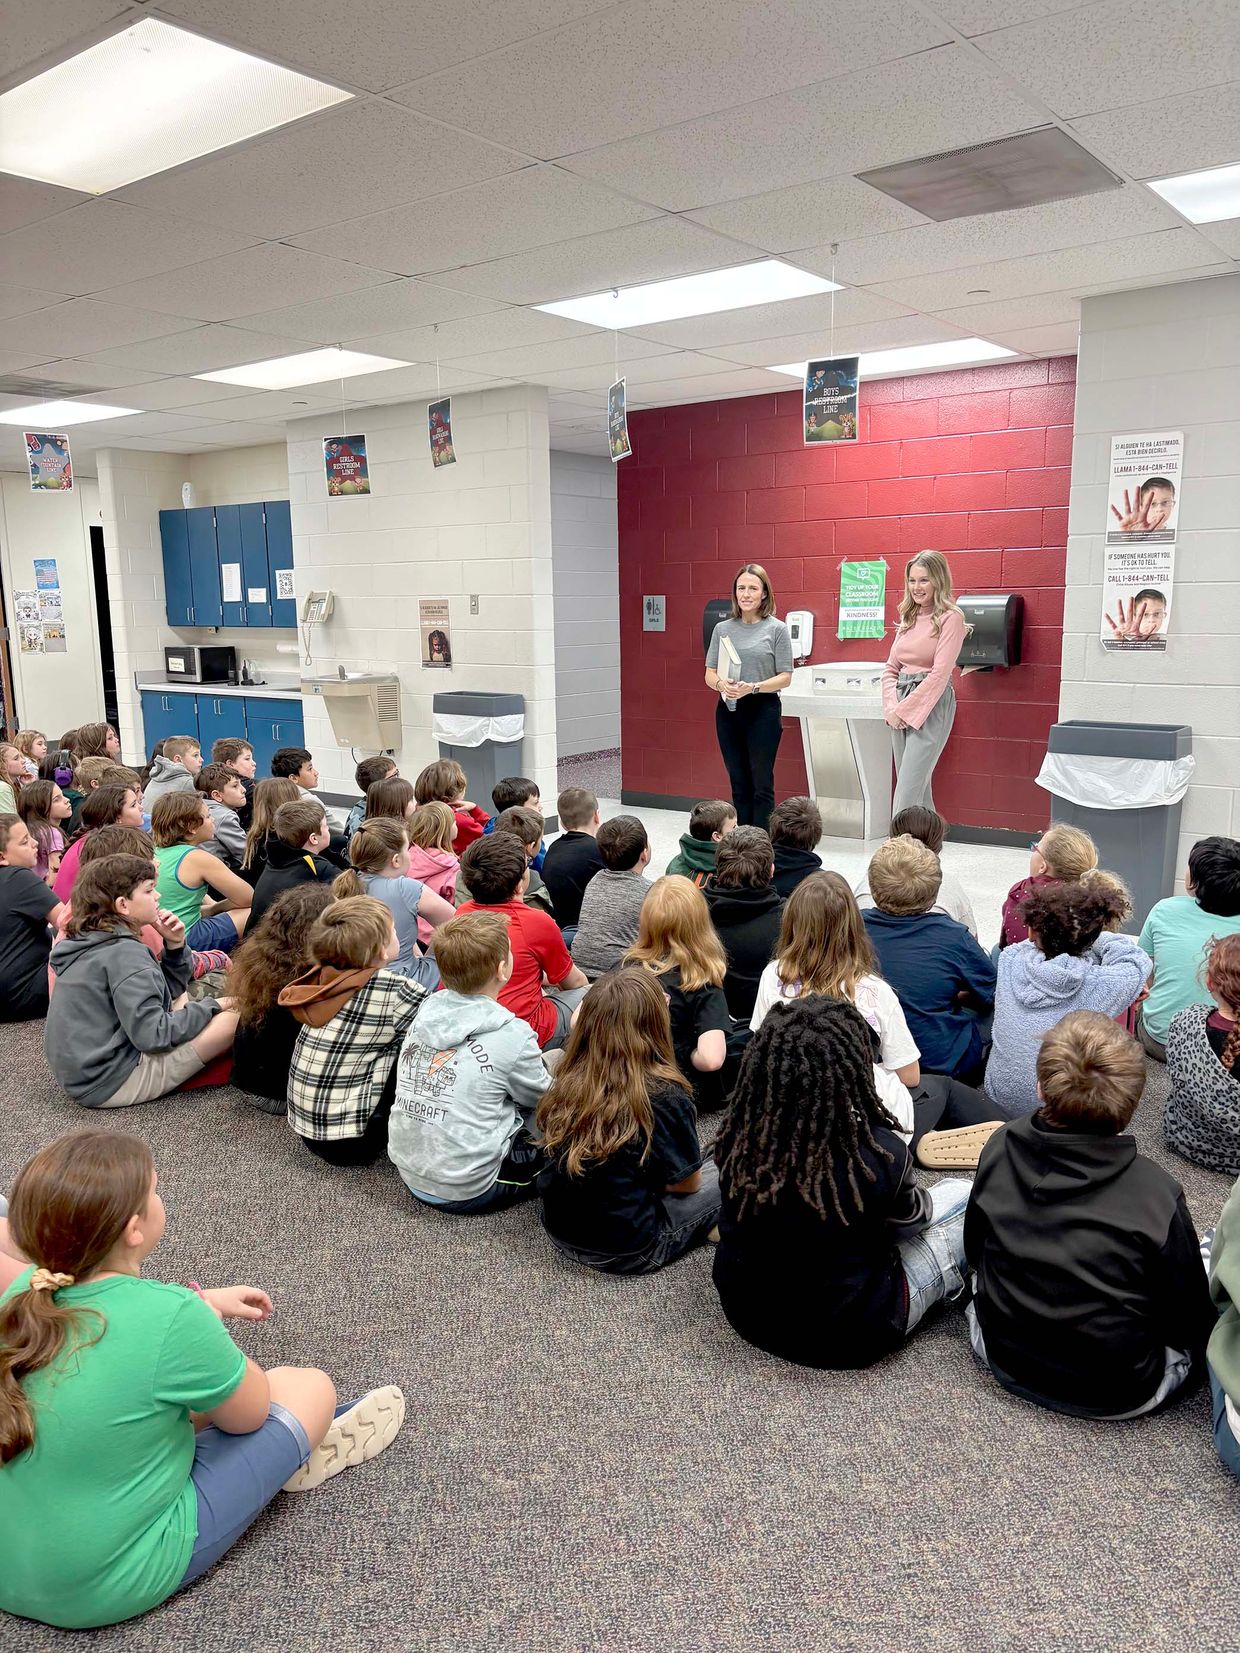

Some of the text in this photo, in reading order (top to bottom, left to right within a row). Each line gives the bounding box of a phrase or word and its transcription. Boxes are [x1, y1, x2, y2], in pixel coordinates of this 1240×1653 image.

[823, 387, 840, 396] BOYS
[814, 395, 848, 406] RESTROOM
[823, 404, 838, 414] LINE
[1132, 462, 1178, 472] 1-844-CAN-TELL
[466, 1035, 494, 1074] MODE
[397, 1096, 448, 1121] MINECRAFT
